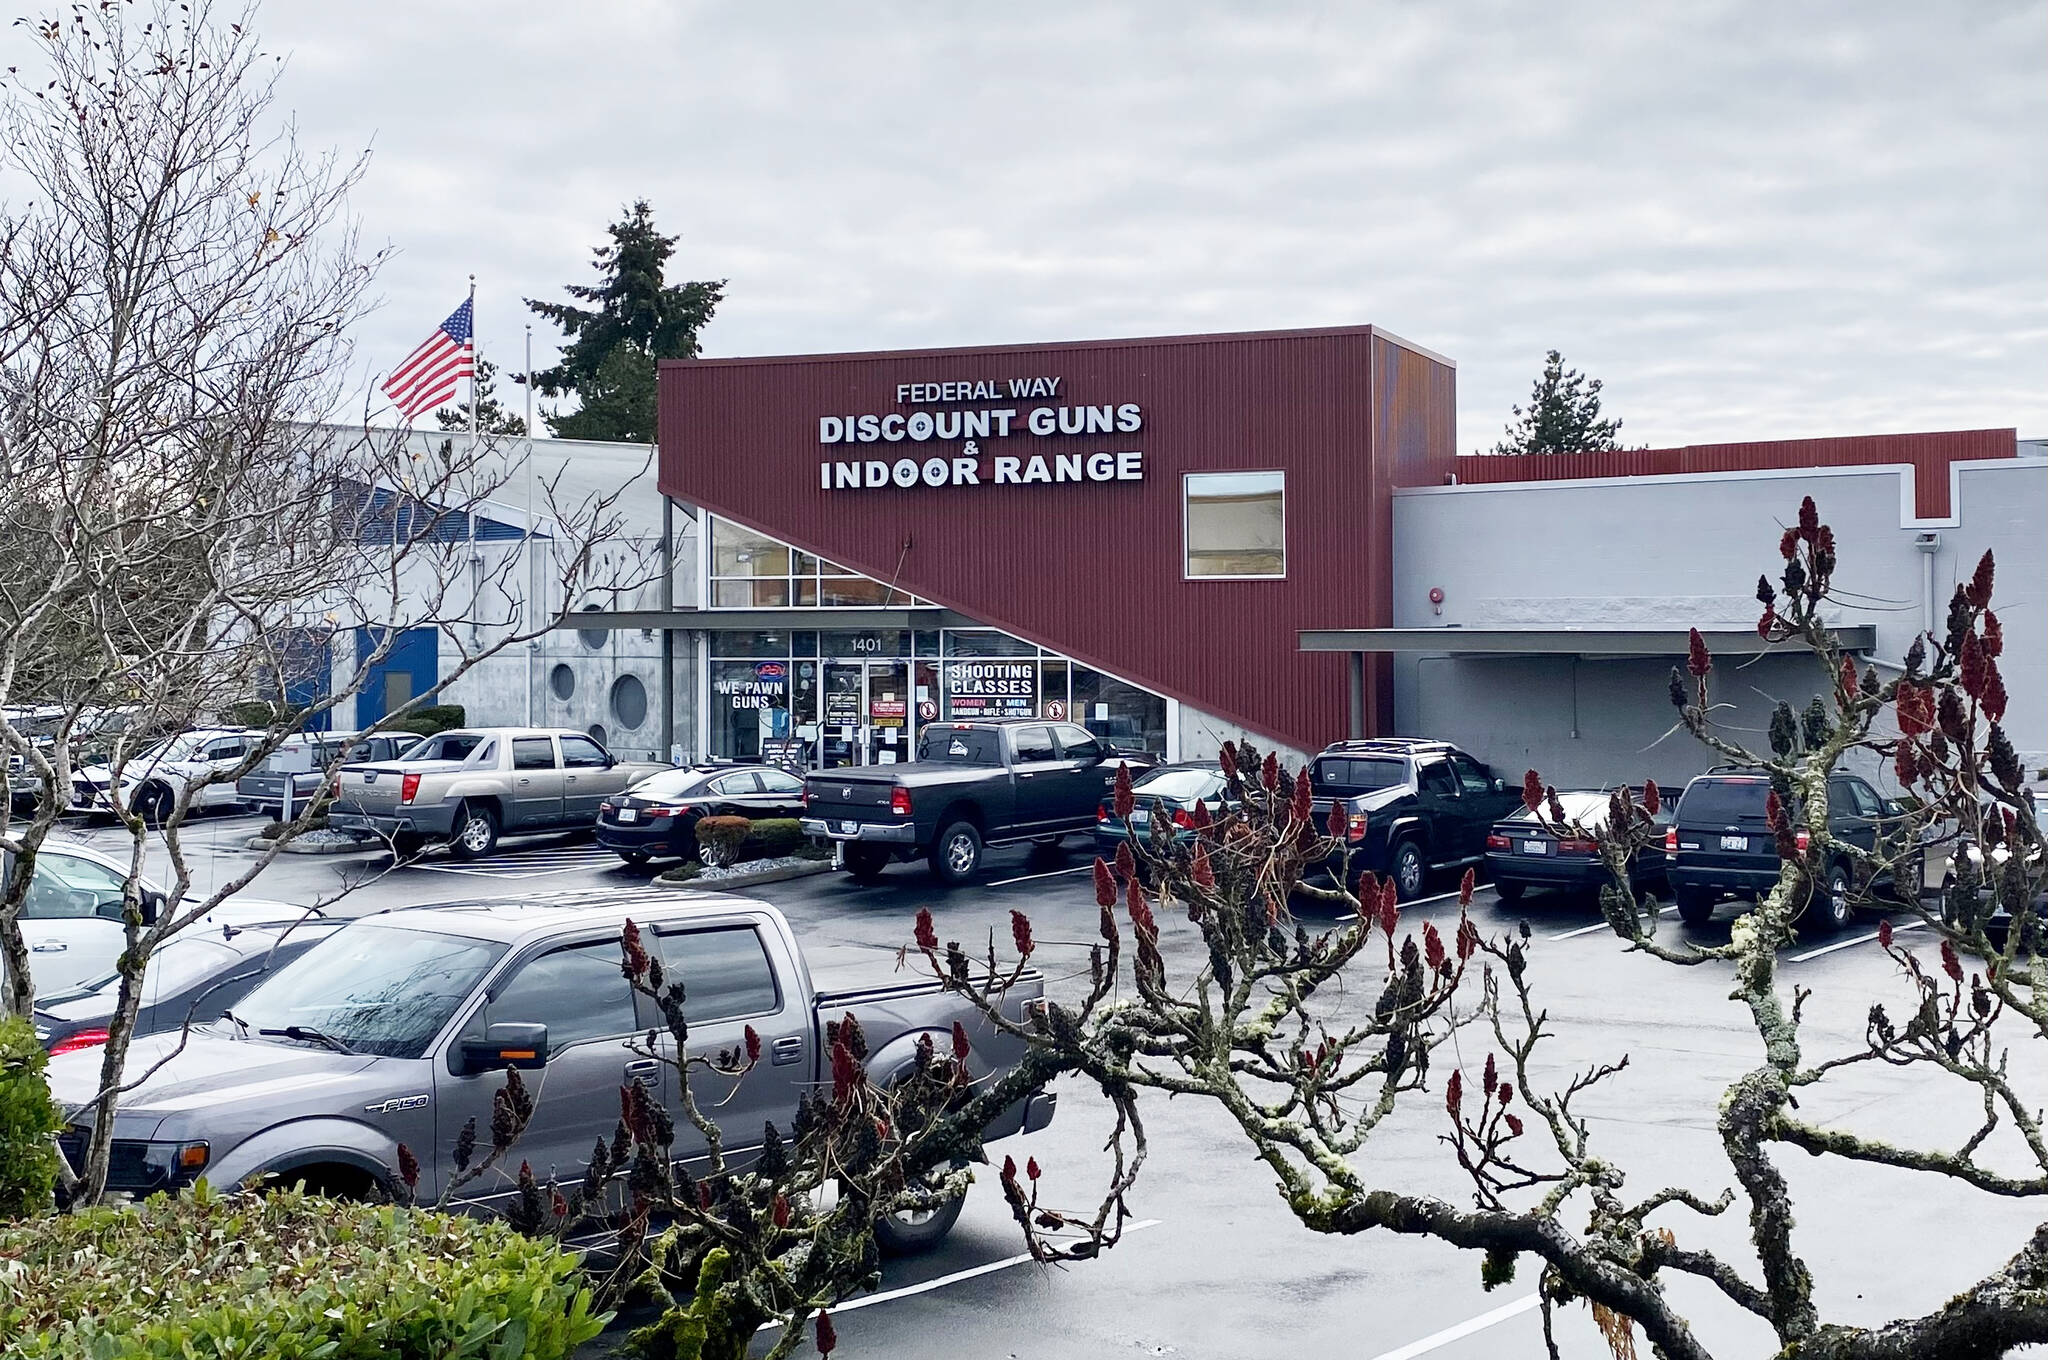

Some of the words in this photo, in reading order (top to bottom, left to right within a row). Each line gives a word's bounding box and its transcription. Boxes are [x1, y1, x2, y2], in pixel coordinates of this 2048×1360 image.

[897, 379, 1002, 403] FEDERAL
[1009, 376, 1061, 398] WAY
[819, 409, 1016, 443] DISCOUNT
[1028, 404, 1142, 436] GUNS
[963, 440, 979, 455] &
[821, 457, 980, 489] INDOOR
[994, 452, 1143, 484] RANGE
[851, 638, 882, 651] 1401
[951, 665, 1032, 678] SHOOTING
[719, 682, 739, 695] WE
[745, 682, 783, 695] PAWN
[951, 680, 1032, 694] CLASSES
[732, 696, 769, 709] GUNS
[951, 699, 986, 707] WOMEN
[1006, 699, 1027, 707] MEN
[983, 708, 1001, 716] RIFLE
[1004, 707, 1032, 716] SHOTGUN
